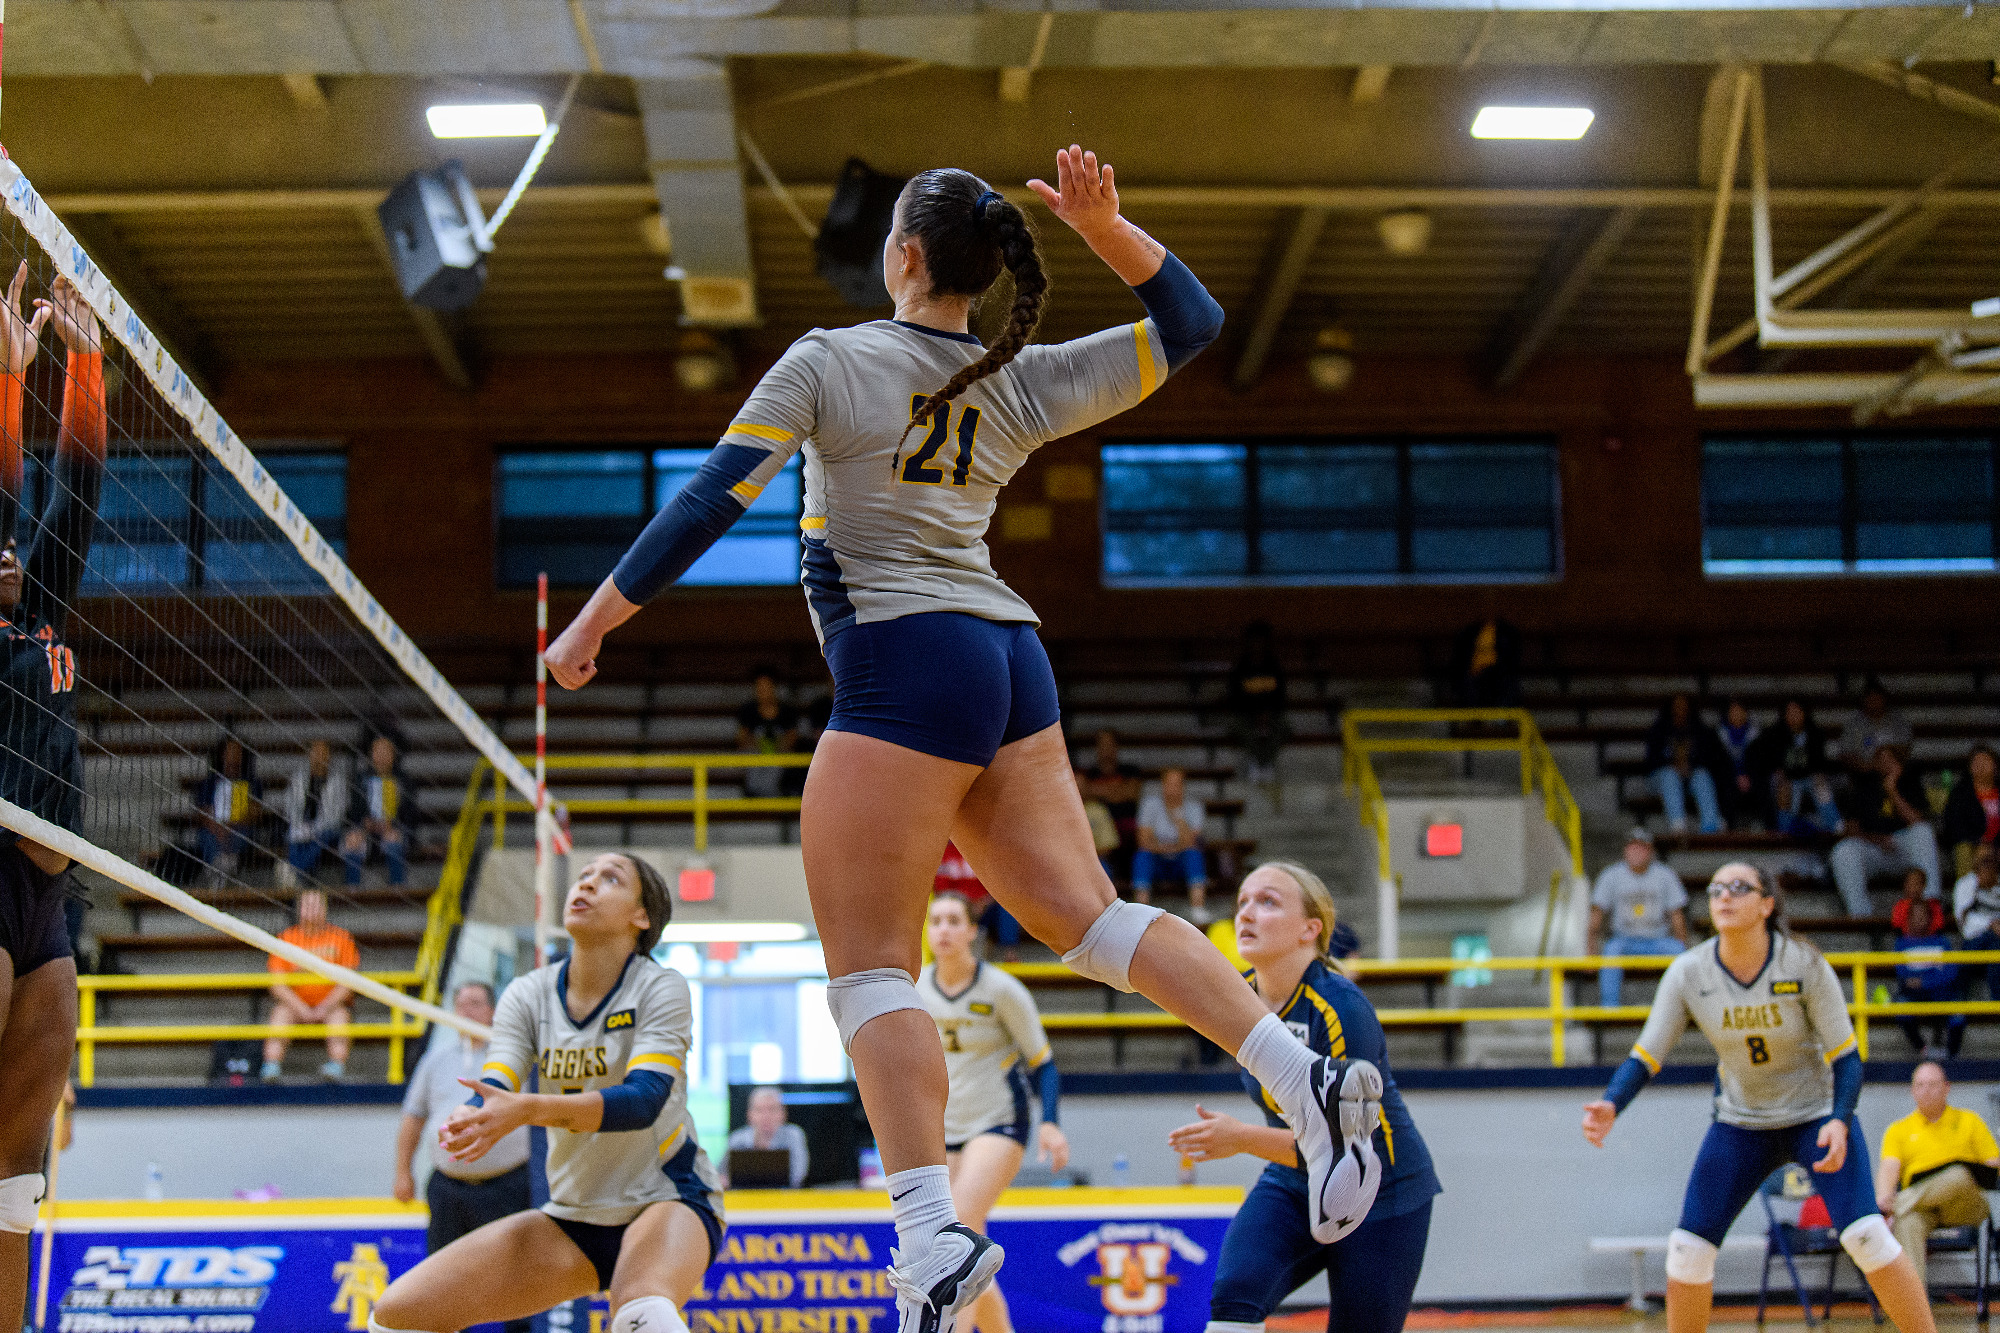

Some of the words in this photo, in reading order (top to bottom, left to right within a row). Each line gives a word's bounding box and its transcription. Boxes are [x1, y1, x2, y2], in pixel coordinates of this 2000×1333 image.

[900, 392, 982, 487] 21
[1722, 1004, 1783, 1031] AGGIES
[540, 1046, 608, 1079] AGGIES
[1745, 1034, 1771, 1066] 8
[715, 1233, 873, 1263] AROLINA
[121, 1246, 285, 1288] TDS
[717, 1271, 794, 1300] AND
[797, 1269, 897, 1299] TECH
